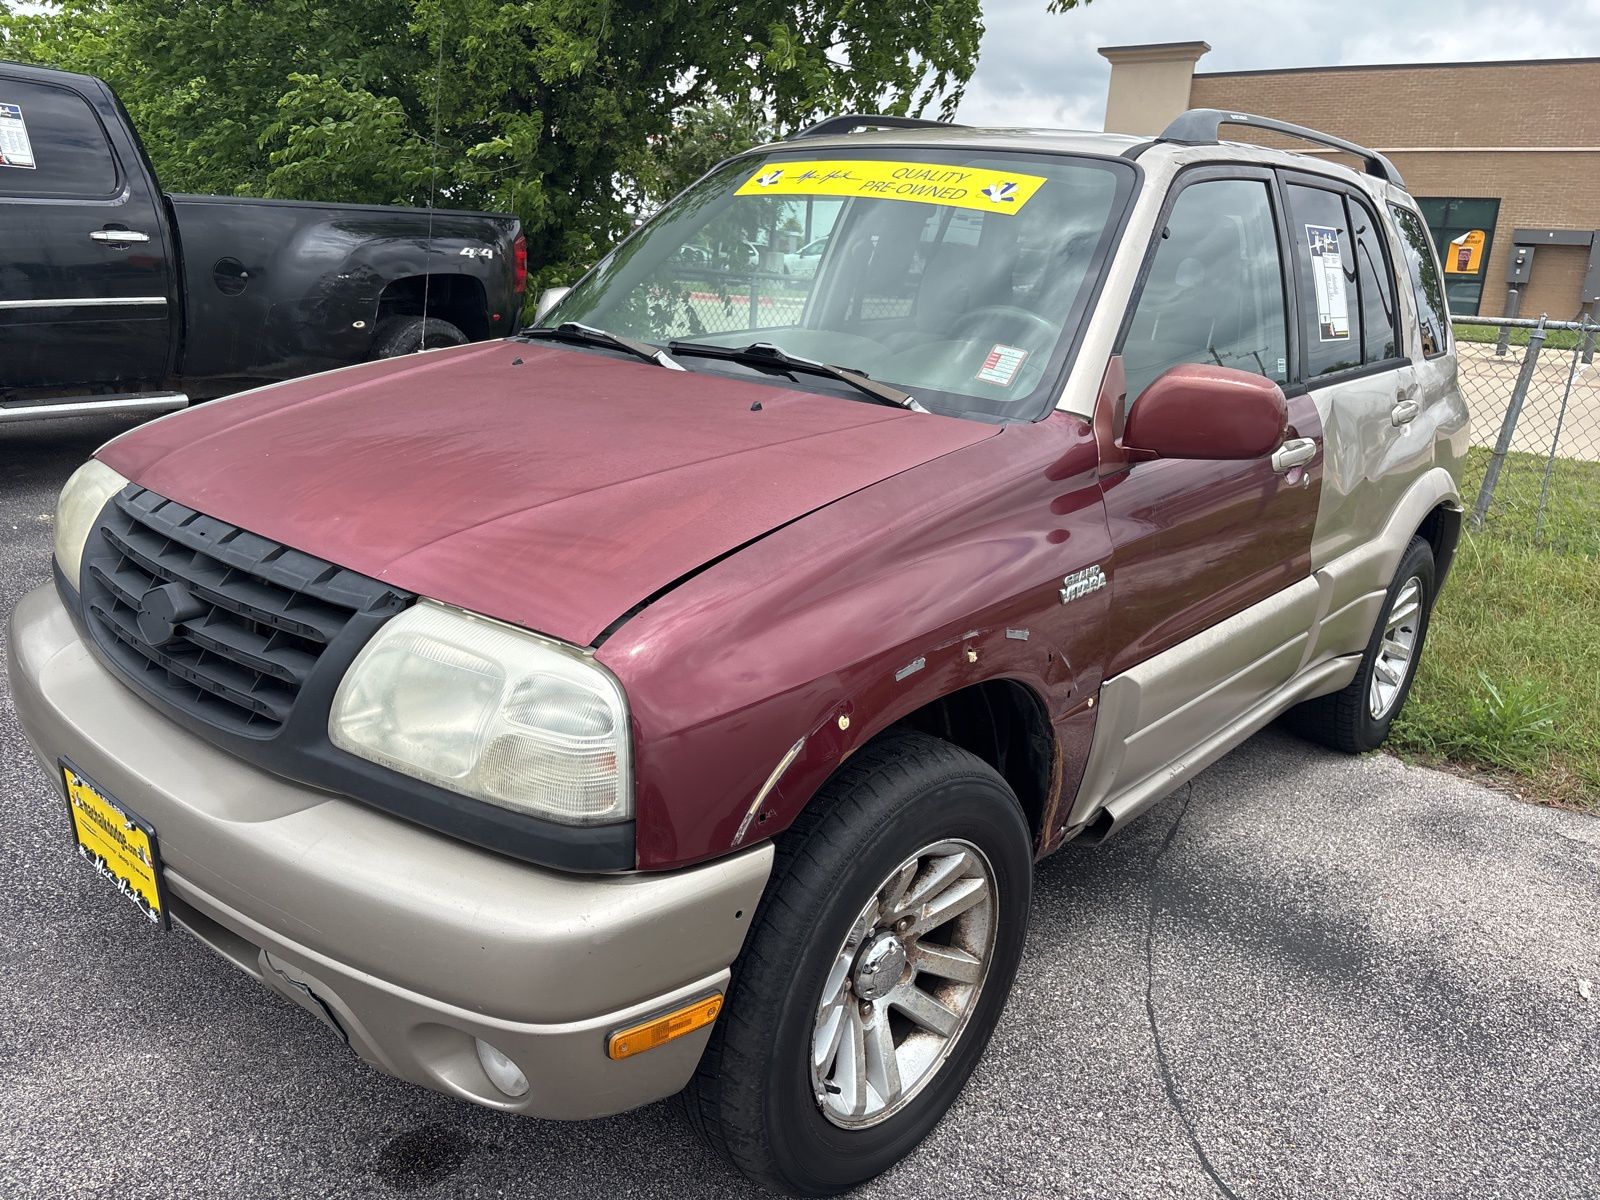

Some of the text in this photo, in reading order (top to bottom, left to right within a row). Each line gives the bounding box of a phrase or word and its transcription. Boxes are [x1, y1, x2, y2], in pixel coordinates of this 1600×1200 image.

[892, 168, 971, 183] QUALITY
[859, 181, 967, 200] PRE-OWNED
[1064, 565, 1101, 587] GRAND
[1059, 572, 1107, 605] VITARA
